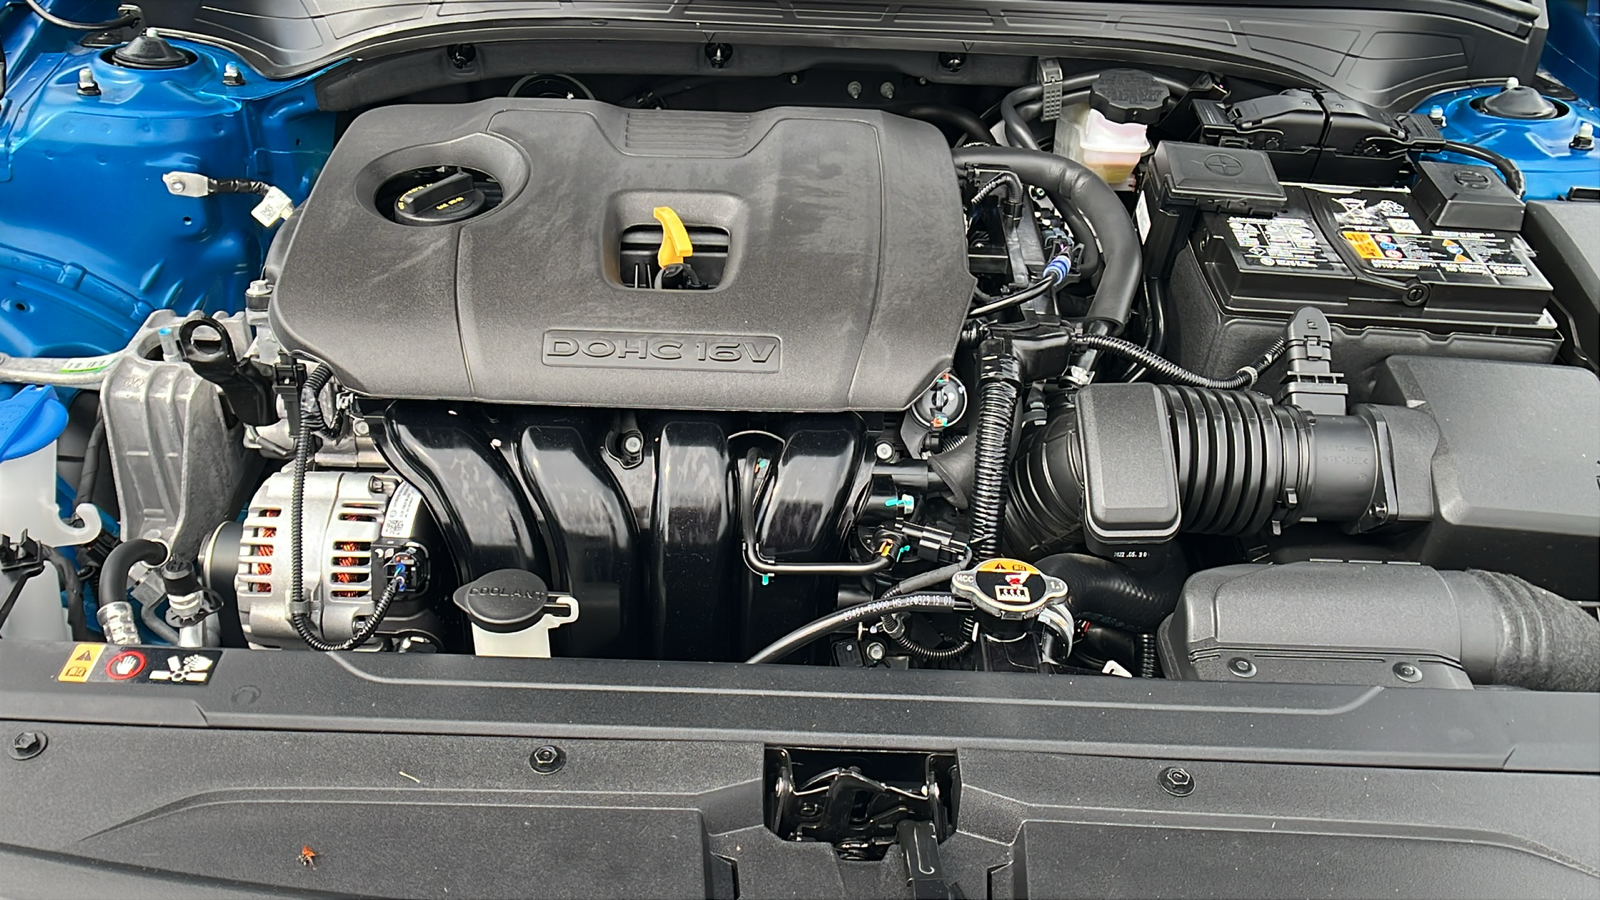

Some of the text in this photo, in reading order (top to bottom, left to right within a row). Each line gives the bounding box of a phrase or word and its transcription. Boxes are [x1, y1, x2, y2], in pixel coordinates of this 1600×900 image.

[546, 336, 777, 363] DOHC 16V
[956, 574, 975, 583] HCC
[1050, 581, 1064, 590] 1.1
[469, 586, 545, 601] COOLANT
